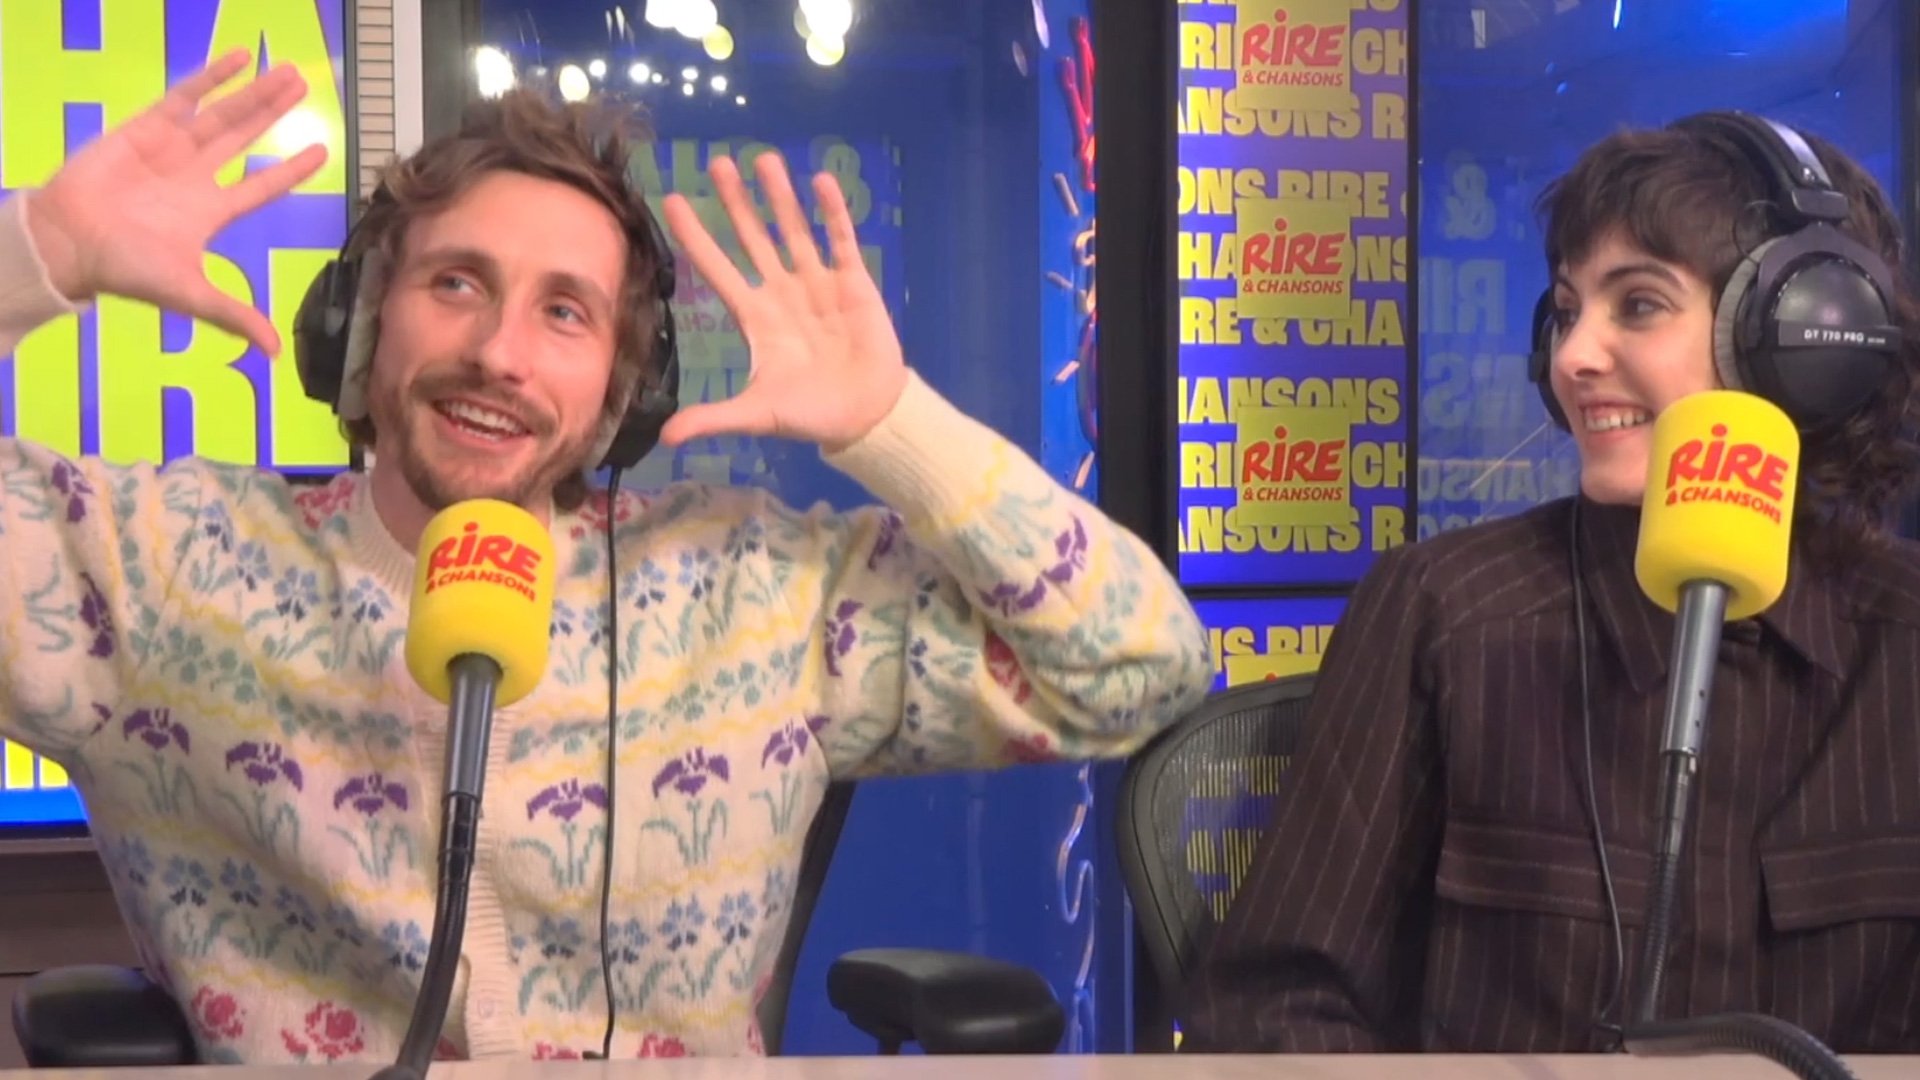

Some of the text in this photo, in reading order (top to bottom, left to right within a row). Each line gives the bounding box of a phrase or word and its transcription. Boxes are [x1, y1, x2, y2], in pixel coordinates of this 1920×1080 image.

[1256, 70, 1344, 87] CHANSONS
[1256, 279, 1344, 295] CHANSONS
[1804, 329, 1819, 340] DT
[1822, 330, 1841, 342] 770
[1844, 331, 1864, 343] PRO
[1256, 487, 1343, 501] CHANSONS
[1680, 486, 1782, 526] CHANSONS
[438, 569, 536, 603] CHANSONS
